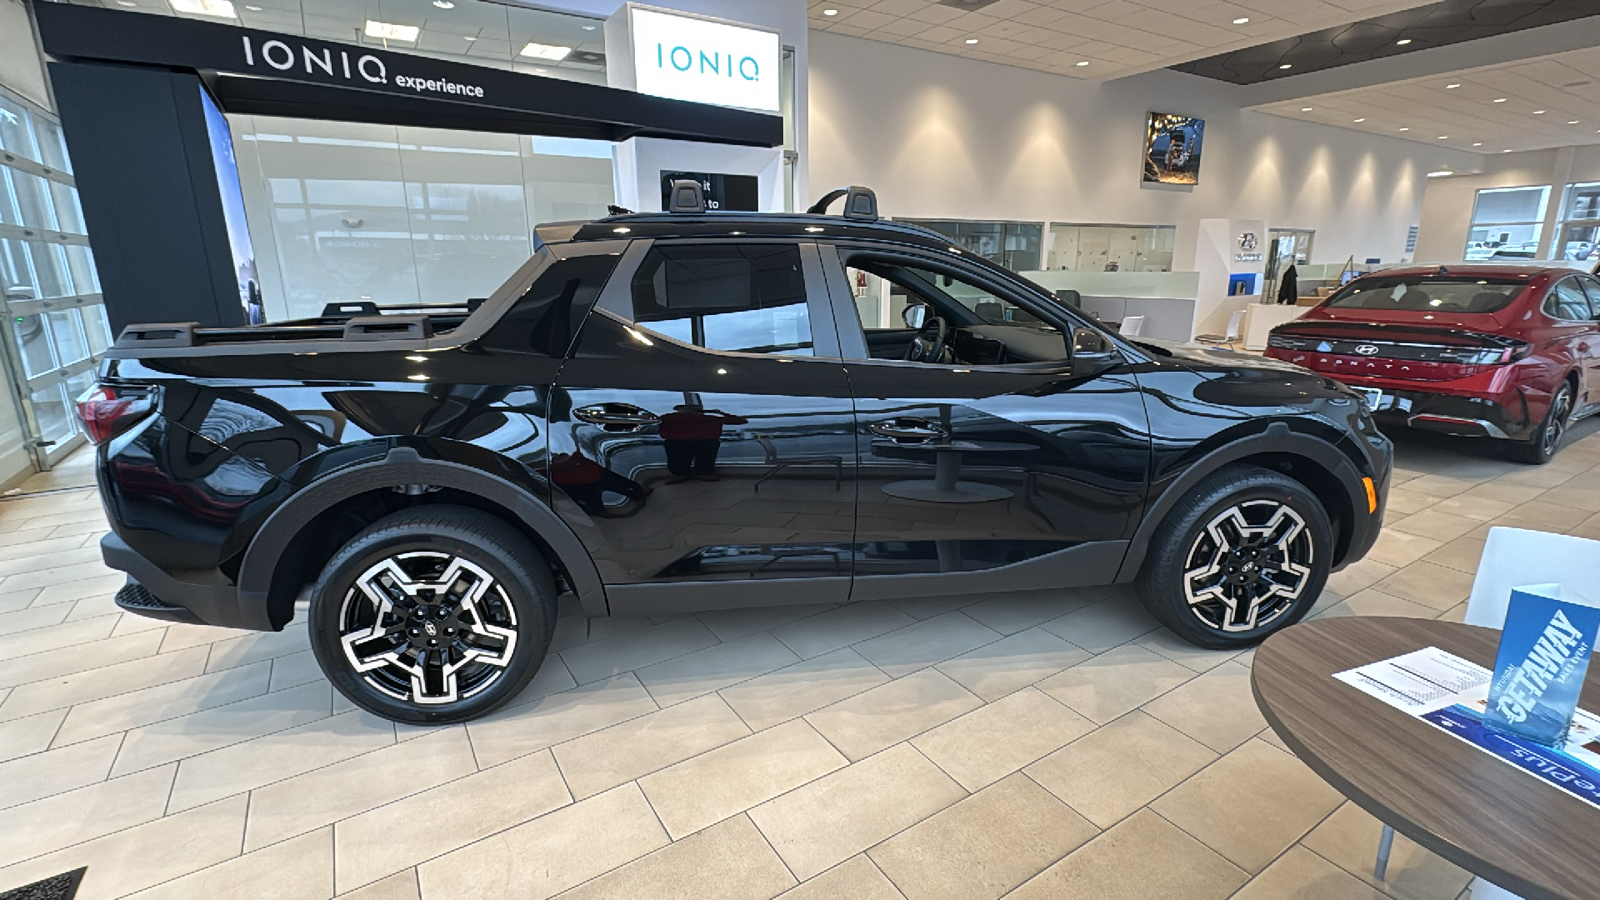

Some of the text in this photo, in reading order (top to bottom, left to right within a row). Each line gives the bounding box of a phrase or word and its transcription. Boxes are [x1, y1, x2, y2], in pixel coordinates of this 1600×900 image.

[242, 35, 484, 98] IONIQ experience
[657, 42, 759, 82] IONIQ
[708, 199, 719, 209] to
[1320, 358, 1410, 371] SONATA
[1494, 663, 1515, 692] HYUNDAI
[1496, 609, 1583, 724] GETAWAY
[1558, 641, 1589, 684] SALES EVENT
